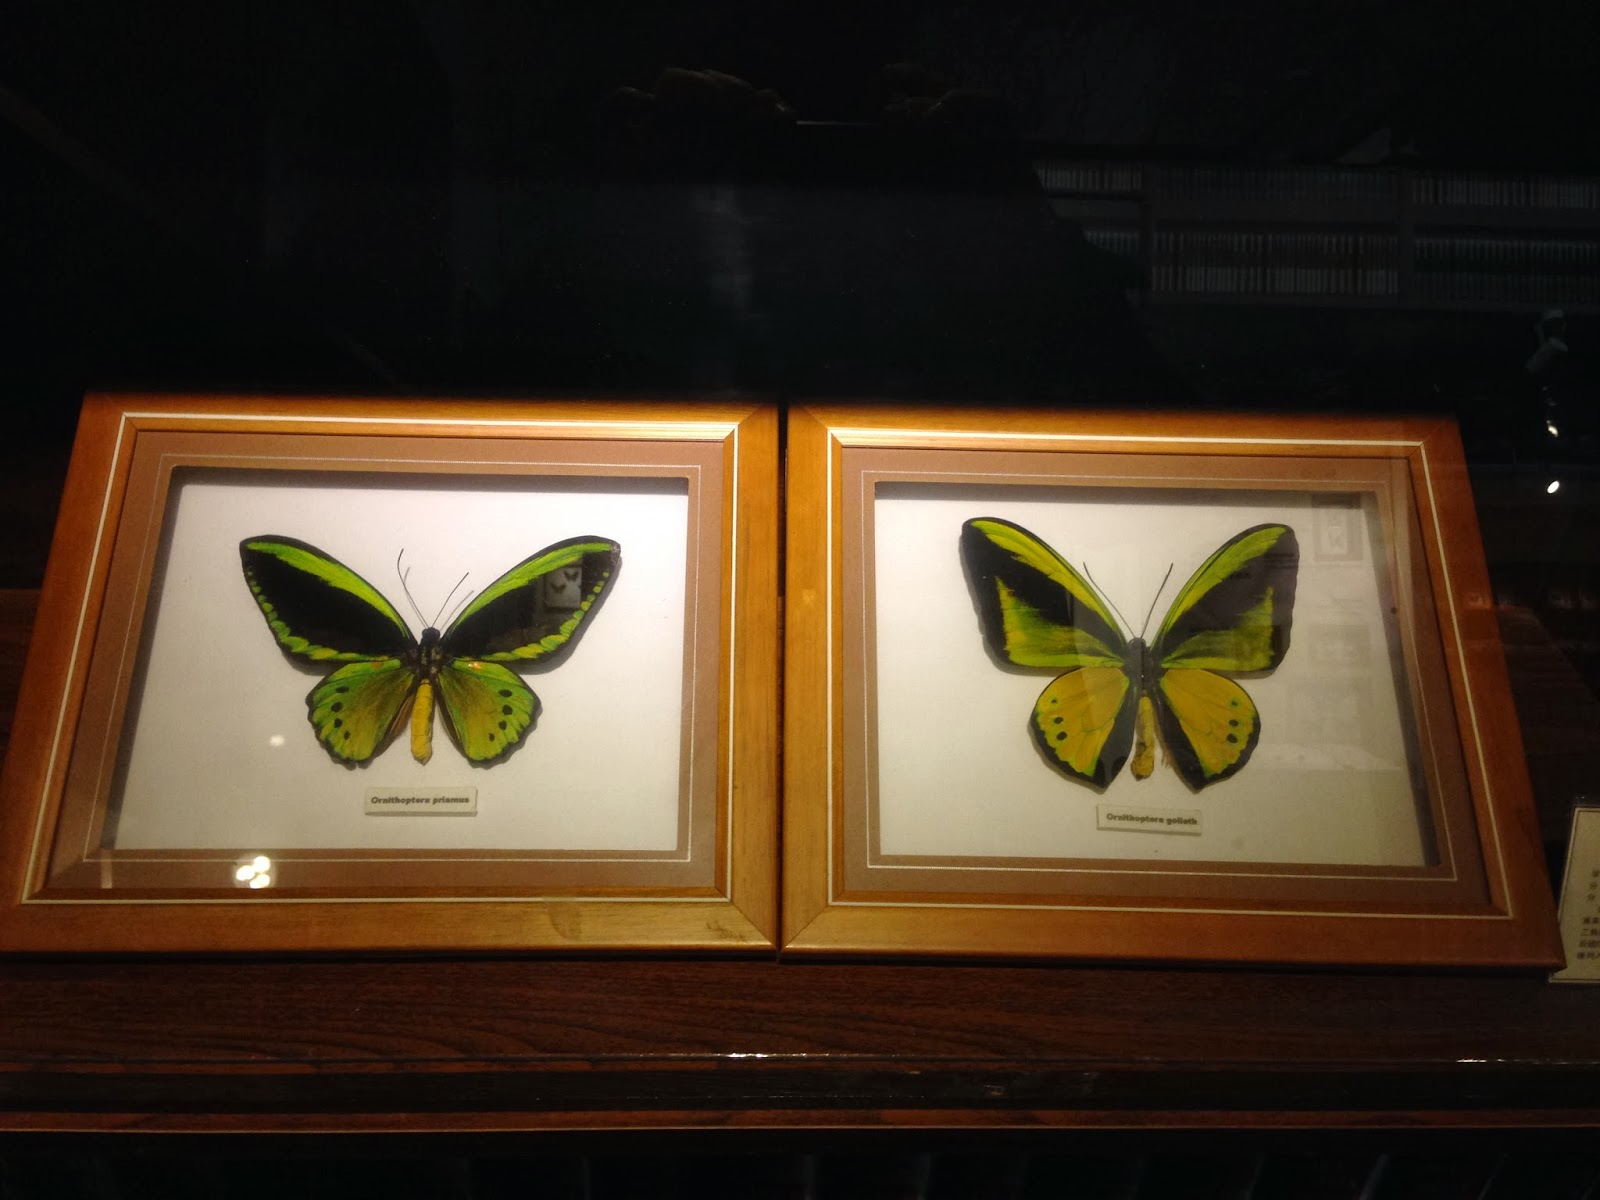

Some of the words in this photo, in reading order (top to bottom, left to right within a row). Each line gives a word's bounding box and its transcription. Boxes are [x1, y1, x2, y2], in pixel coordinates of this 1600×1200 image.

[371, 796, 430, 805] Ornithoptera
[1106, 813, 1164, 823] Ornithoptera
[1166, 817, 1198, 825] goliath
